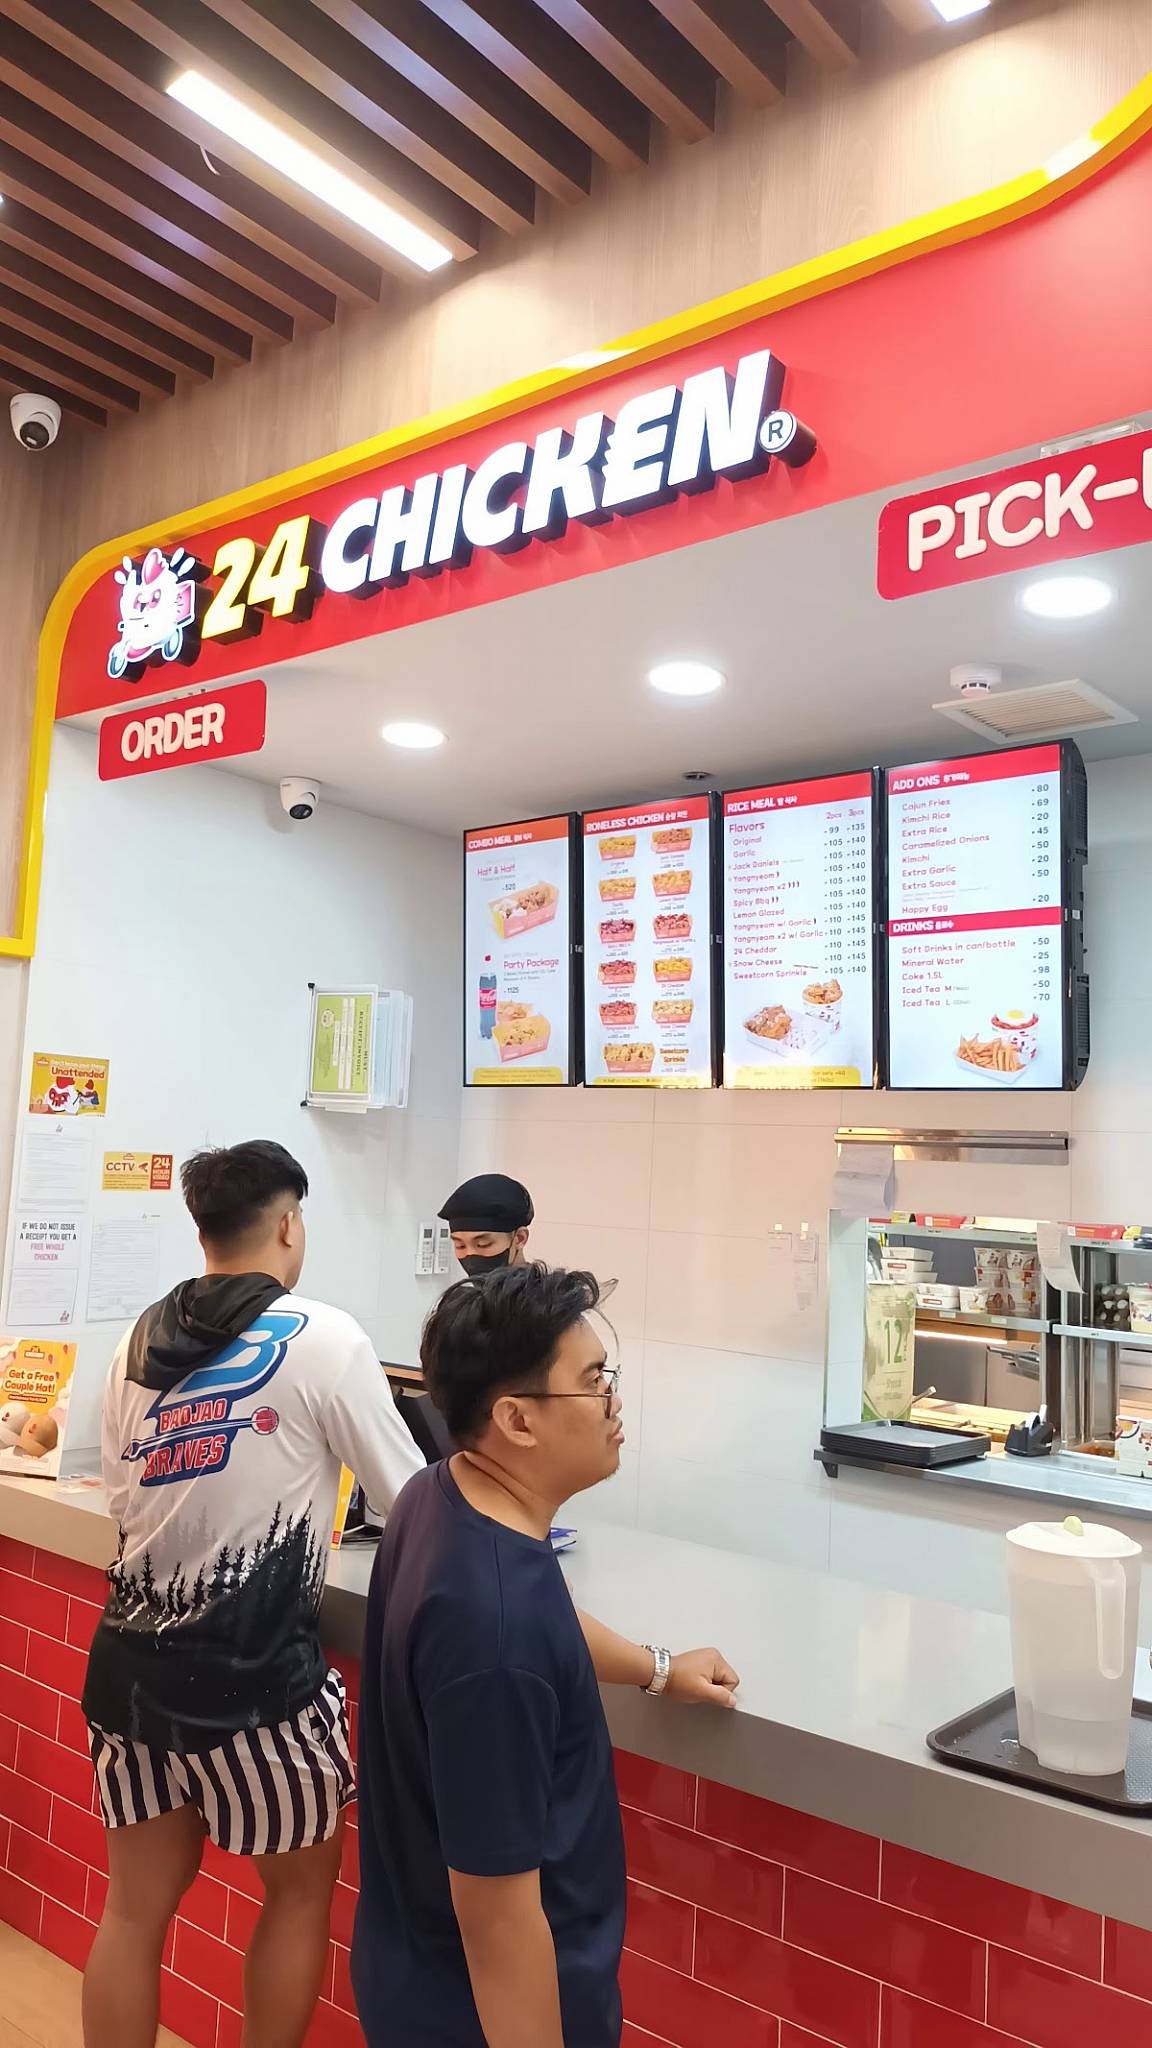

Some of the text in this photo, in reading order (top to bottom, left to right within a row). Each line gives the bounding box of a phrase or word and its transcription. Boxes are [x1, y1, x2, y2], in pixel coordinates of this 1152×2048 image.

[201, 514, 311, 640] 24
[320, 348, 772, 594] CHICKEN
[908, 448, 1152, 571] PICK-
[120, 702, 225, 762] ORDER
[892, 779, 914, 791] ADD
[916, 774, 940, 787] ONS
[727, 801, 750, 813] RICE
[751, 798, 776, 810] MEAL
[902, 800, 927, 812] Cajun
[928, 798, 950, 807] Fries
[586, 818, 627, 832] BONELESS
[627, 812, 664, 826] CHICKEN
[902, 814, 930, 824] Kimchi
[932, 812, 951, 821] Rice
[729, 822, 765, 833] Flavors
[902, 828, 926, 838] Extra
[929, 825, 948, 834] Rice
[733, 836, 762, 846] Original
[902, 838, 956, 851] Caramelized
[959, 834, 990, 844] Onions
[733, 850, 756, 858] Garlic
[902, 854, 930, 864] Kimchi
[752, 860, 780, 868] Daniels
[902, 868, 927, 878] Extra
[929, 865, 956, 875] Garlic
[902, 882, 927, 891] Extra
[929, 879, 956, 888] Sauce
[733, 900, 753, 908] Spicy
[902, 904, 929, 915] Happy
[932, 903, 948, 912] Egg
[758, 908, 784, 917] Glazed
[788, 918, 811, 926] Garlic
[892, 920, 934, 933] DRINKS
[800, 930, 823, 938] Garlic
[745, 946, 777, 954] Cheddar
[902, 946, 922, 954] Soft
[924, 944, 952, 952] Drinks
[966, 940, 1016, 950] can/bottle
[504, 959, 559, 968] Party Package
[902, 959, 934, 968] Mineral
[936, 956, 964, 966] Water
[733, 972, 774, 980] Sweetcorn
[776, 970, 807, 978] Sprinkle
[902, 972, 924, 981] Coke
[927, 971, 943, 980] 1.5L
[902, 985, 922, 994] Iced
[925, 985, 940, 994] Tea
[902, 999, 922, 1008] Iced
[925, 999, 940, 1007] Tea
[52, 1066, 105, 1078] Unattended
[106, 1162, 135, 1171] CCTV
[153, 1157, 170, 1168] 24
[9, 1370, 25, 1379] Get
[35, 1372, 54, 1381] Free
[5, 1380, 55, 1393] Couple Hat!
[143, 1435, 226, 1480] BRAVES
